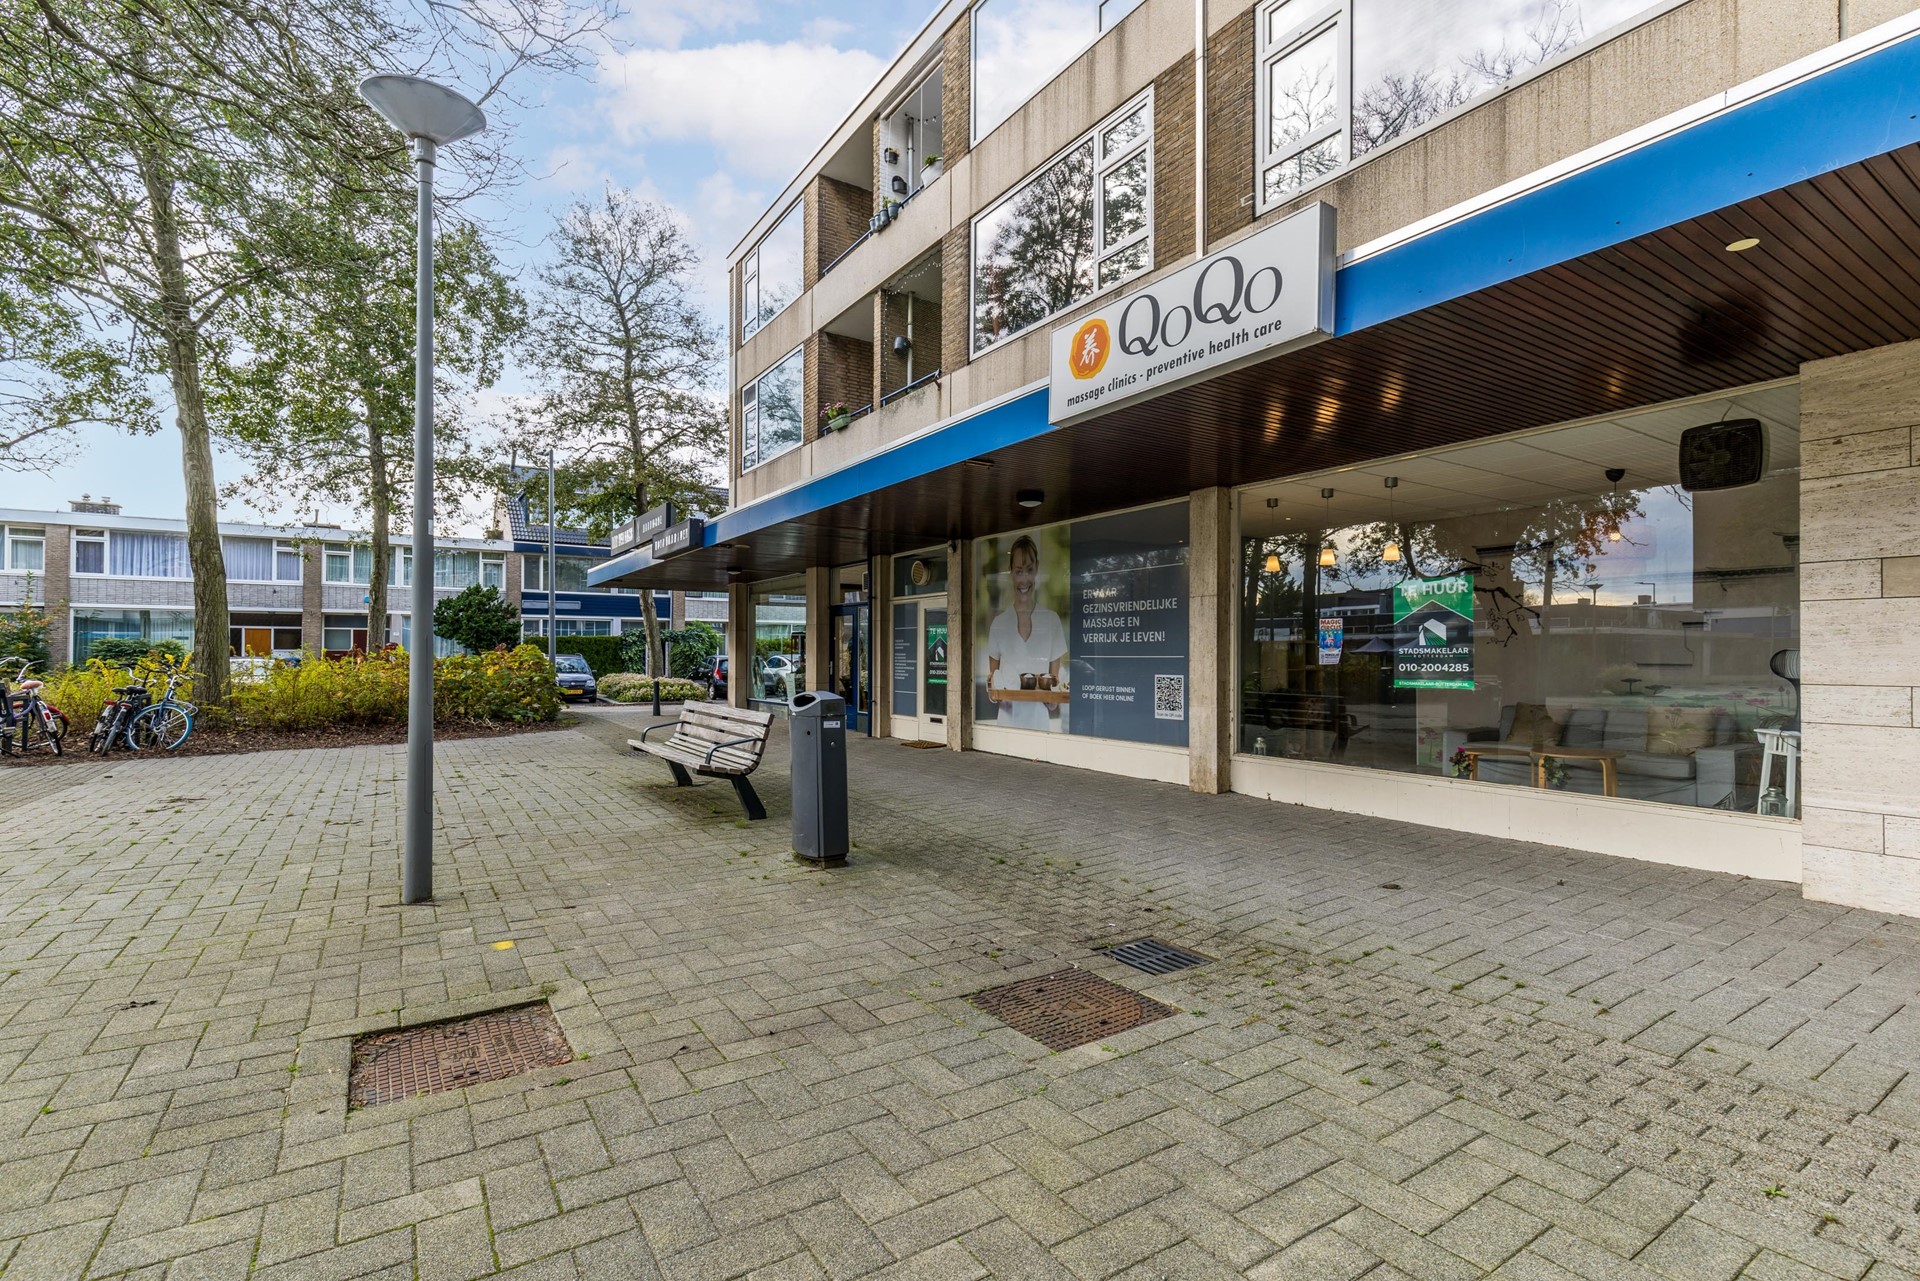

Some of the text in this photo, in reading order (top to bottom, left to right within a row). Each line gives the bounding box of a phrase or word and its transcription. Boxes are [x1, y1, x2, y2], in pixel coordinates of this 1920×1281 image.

[1119, 256, 1283, 356] QoQo
[1067, 385, 1105, 407] massage
[1108, 373, 1137, 392] clinics
[1146, 348, 1205, 381] preventive
[1209, 328, 1249, 355] health
[1254, 319, 1282, 339] care
[1083, 587, 1117, 599] ERVAAR
[1400, 580, 1469, 597] TE HUUR
[1082, 598, 1177, 613] GEZINSVRIENDELIJKE
[1083, 616, 1140, 628] MASSAGE EN
[937, 627, 947, 635] HUU
[1082, 631, 1166, 643] VERRIJK JE LEVEN!
[1399, 647, 1469, 655] STADSMAKELAAR
[1399, 663, 1470, 672] 010-2004285
